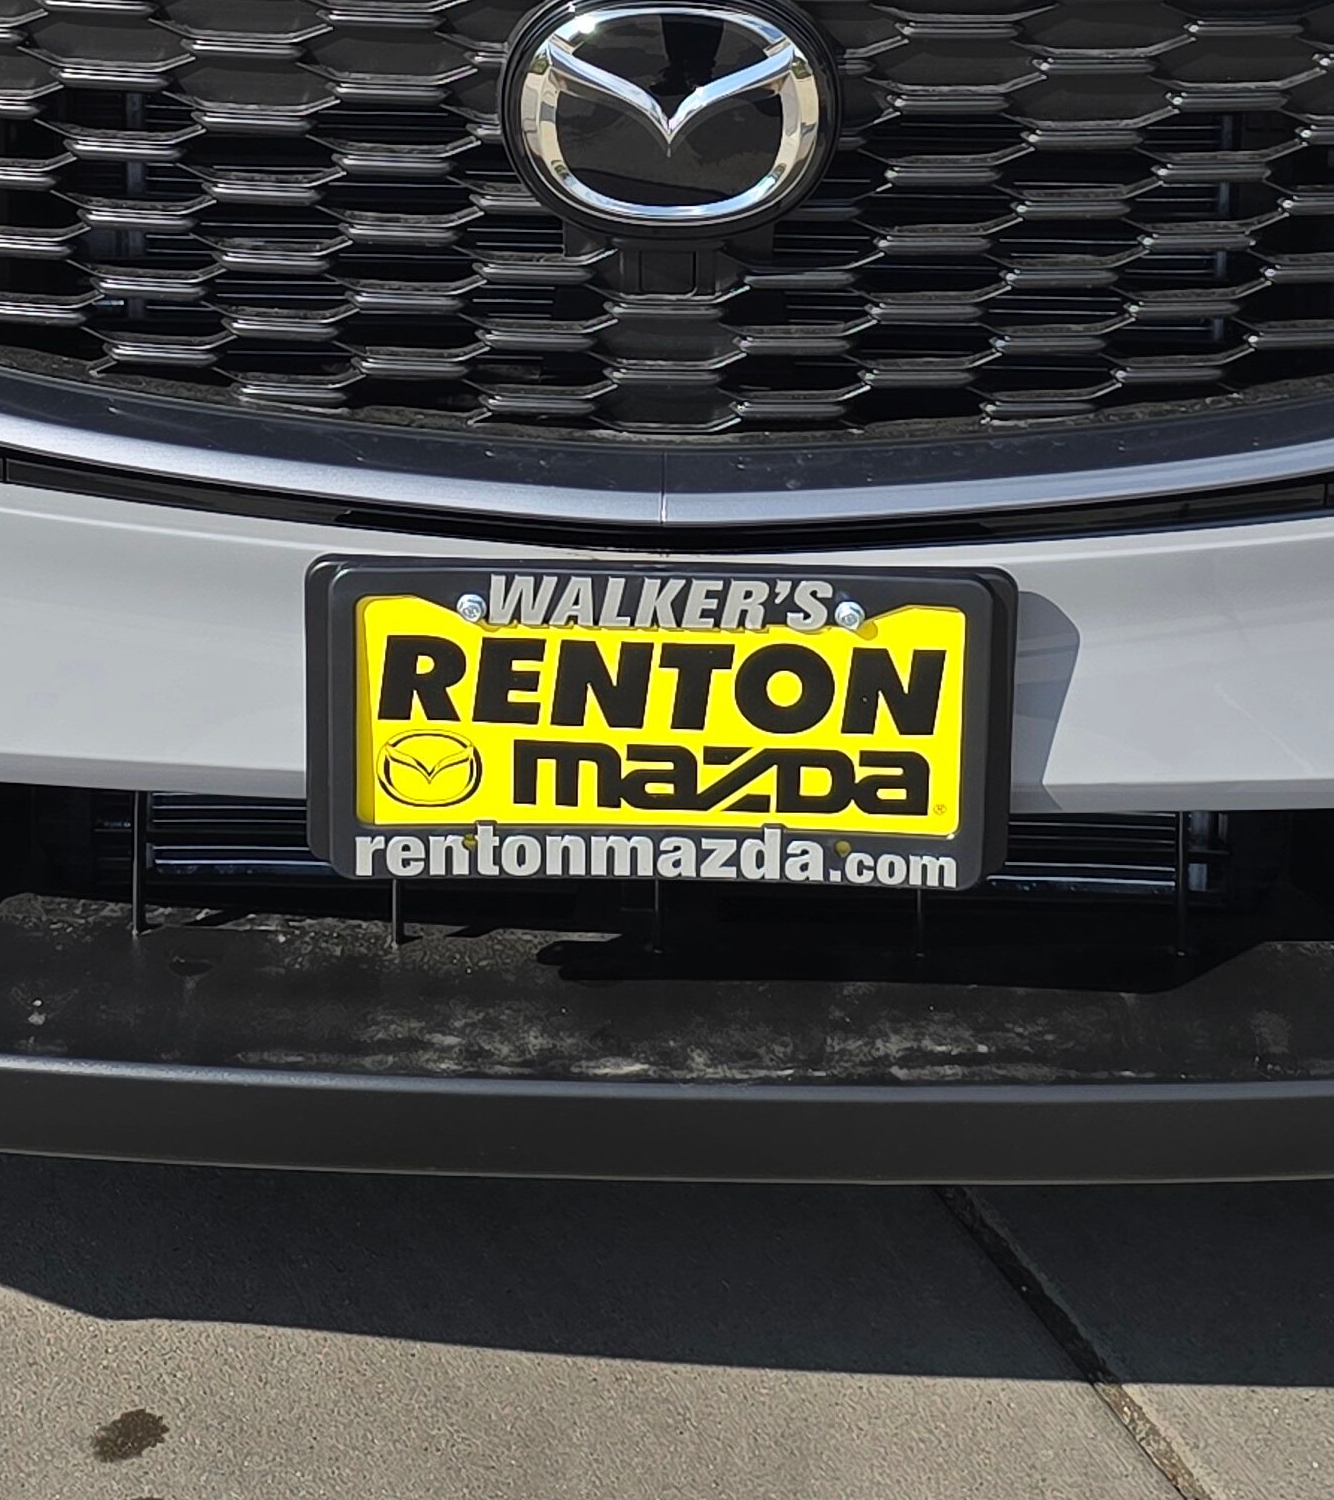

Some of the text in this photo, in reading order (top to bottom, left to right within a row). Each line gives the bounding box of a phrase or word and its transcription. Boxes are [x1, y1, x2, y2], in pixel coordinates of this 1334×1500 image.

[489, 574, 834, 632] WALKER'S
[378, 635, 947, 736] RENTON
[354, 823, 957, 889] rentonmazda.com
